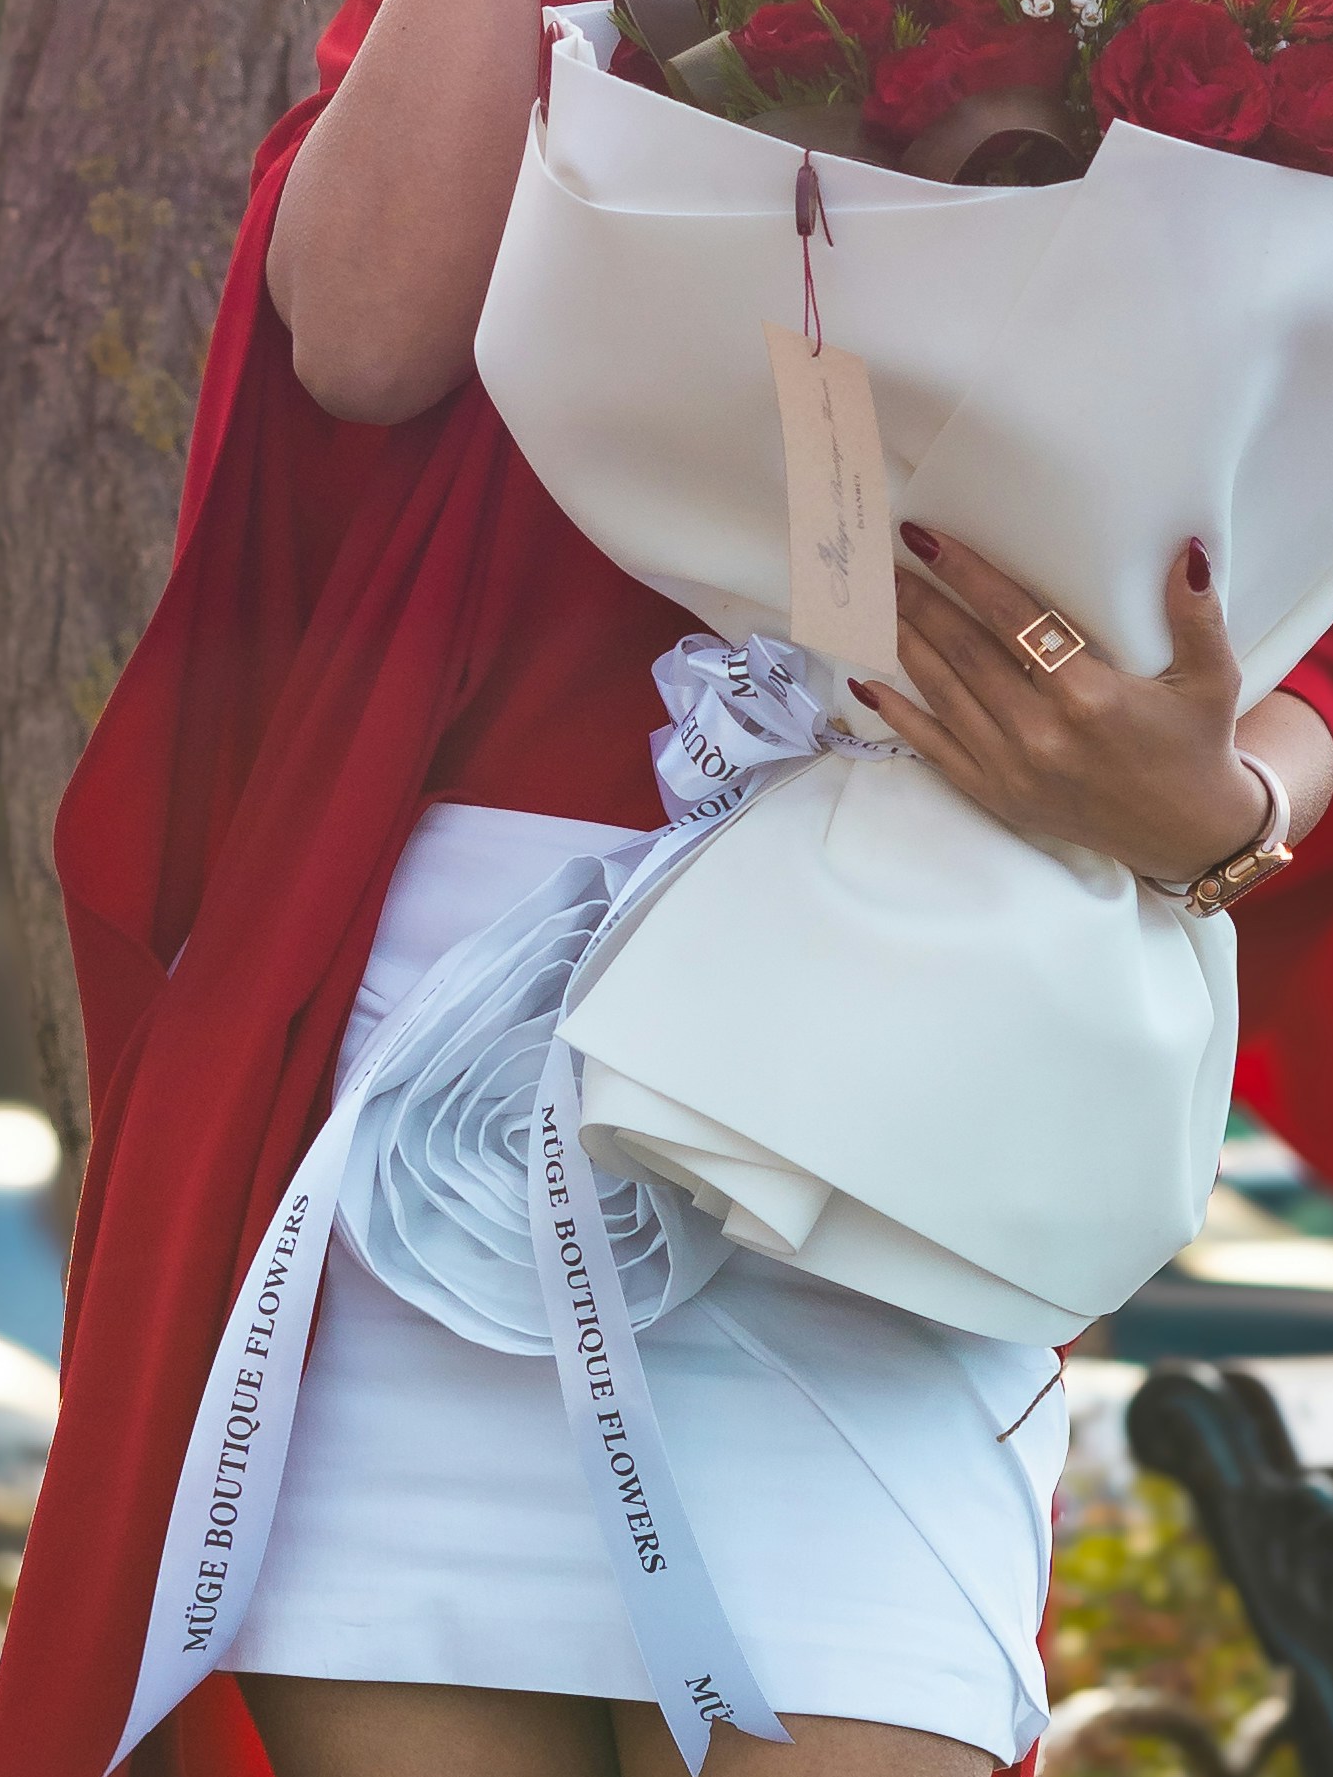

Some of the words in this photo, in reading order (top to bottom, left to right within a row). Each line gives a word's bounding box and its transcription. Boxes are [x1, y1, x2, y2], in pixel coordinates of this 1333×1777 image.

[680, 715, 741, 782] IQUE
[540, 1102, 571, 1209] MÜGE
[244, 1193, 310, 1360] FLOWERS
[553, 1216, 615, 1402] BOUTIQUE
[203, 1368, 265, 1551] BOUTIQUE
[596, 1408, 669, 1575] FLOWERS
[181, 1560, 229, 1654] MÜGE
